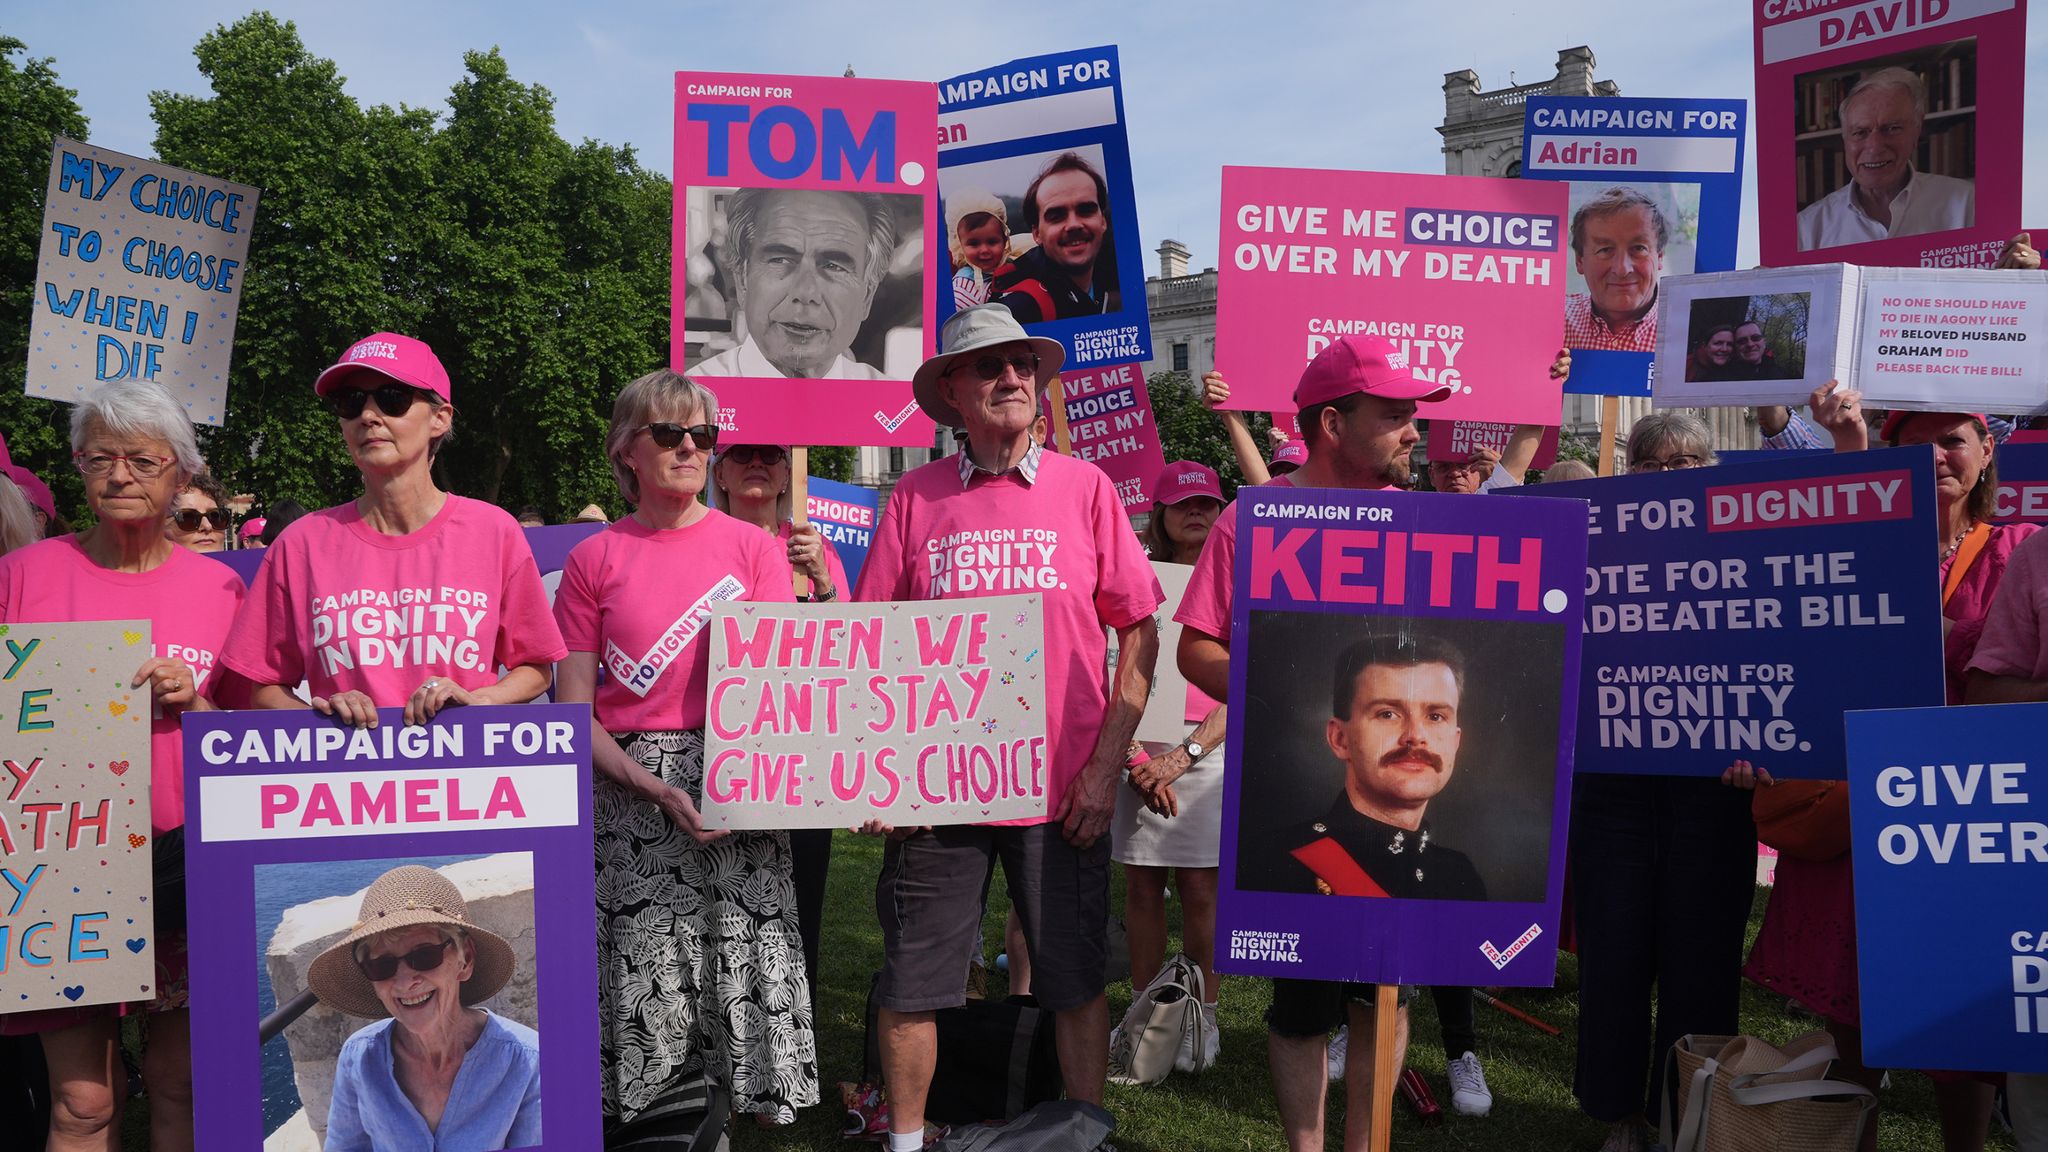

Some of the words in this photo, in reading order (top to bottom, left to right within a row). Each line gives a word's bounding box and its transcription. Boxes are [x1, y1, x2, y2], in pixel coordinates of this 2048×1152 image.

[1819, 0, 1949, 47] DAVID
[1058, 59, 1111, 86] FOR
[687, 84, 762, 98] CAMPAIGN
[765, 86, 793, 99] FOR
[1533, 108, 1673, 130] CAMPAIGN
[1683, 110, 1737, 131] FOR
[1537, 141, 1637, 166] Adrian
[59, 151, 124, 201] MY
[130, 174, 243, 234] CHOICE
[1236, 204, 1328, 235] GIVE
[1342, 208, 1397, 239] ME
[1410, 213, 1553, 248] CHOICE
[52, 223, 101, 263] TO
[123, 237, 239, 293] CHOOSE
[1921, 244, 1978, 258] CAMPAIGN
[1982, 240, 2005, 249] FOR
[1921, 249, 2002, 269] DIGNITY
[1234, 243, 1338, 276] OVER
[1353, 247, 1412, 278] MY
[1424, 252, 1551, 286] DEATH
[45, 282, 167, 340] WHEN
[182, 312, 199, 345] I
[1882, 298, 1901, 307] NO
[1904, 298, 1931, 308] ONE
[1934, 299, 1988, 309] SHOULD
[1991, 301, 2026, 310] HAVE
[1074, 328, 1118, 340] CAMPAIGN
[1121, 325, 1139, 334] FOR
[1307, 318, 1416, 338] CAMPAIGN
[1423, 324, 1465, 340] FOR
[1881, 313, 1897, 322] TO
[1900, 314, 1921, 323] DIE
[1924, 315, 1938, 323] IN
[1940, 315, 1986, 325] AGONY
[1990, 316, 2018, 326] LIKE
[1074, 333, 1139, 352] DIGNITY
[1879, 329, 1899, 338] MY
[1901, 330, 1959, 340] BELOVED
[1962, 331, 2027, 342] HUSBAND
[96, 334, 164, 382] DIE
[1076, 351, 1092, 362] IN
[1094, 344, 1145, 360] DYING.
[1878, 345, 1943, 357] GRAHAM
[1945, 349, 1969, 358] DID
[1101, 366, 1133, 388] ME
[1876, 363, 1923, 373] PLEASE
[1926, 364, 1960, 375] BACK
[1963, 366, 1988, 376] THE
[1991, 367, 2022, 377] BILL!
[1065, 389, 1134, 420] HOICE
[877, 413, 890, 427] YES
[1114, 409, 1145, 432] MY
[1454, 420, 1506, 432] CAMPAIGN
[1452, 440, 1469, 454] IN
[1126, 478, 1141, 486] FOR
[807, 498, 872, 526] CHOICE
[1253, 503, 1350, 520] CAMPAIGN
[1356, 507, 1393, 522] FOR
[1617, 498, 1695, 532] FOR
[1711, 478, 1903, 526] DIGNITY
[814, 521, 869, 547] DEATH
[927, 529, 1015, 552] CAMPAIGN
[1023, 529, 1058, 543] FOR
[929, 542, 1058, 577] DIGNITY
[1665, 559, 1748, 592] FOR
[1764, 552, 1856, 587] THE
[930, 572, 952, 599] IN
[958, 566, 1068, 592] DYING.
[312, 588, 432, 616] CAMPAIGN
[440, 586, 488, 609] FOR
[1801, 593, 1905, 627] BILL
[312, 604, 487, 649] DIGNITY
[721, 615, 884, 671] WHEN
[911, 613, 990, 667] WE
[167, 644, 214, 668] FOR
[318, 644, 354, 678] IN
[359, 634, 486, 673] DYING.
[605, 646, 635, 680] YES
[1597, 664, 1729, 684] CAMPAIGN
[1740, 663, 1795, 682] FOR
[867, 668, 990, 735] STAY
[1598, 684, 1795, 717] DIGNITY
[200, 724, 464, 765] CAMPAIGN
[483, 721, 575, 756] FOR
[1600, 719, 1642, 749] IN
[1652, 718, 1812, 752] DYING.
[705, 748, 807, 807] GIVE
[829, 745, 901, 809] US
[917, 735, 1045, 805] CHOICE
[1876, 762, 2029, 807] GIVE
[260, 776, 526, 829] PAMELA
[1877, 822, 2048, 865] OVER
[1231, 936, 1299, 951] DIGNITY
[1232, 930, 1279, 939] CAMPAIGN
[1230, 948, 1246, 959] IN
[1249, 949, 1303, 963] DYING.
[1483, 943, 1499, 961] YES
